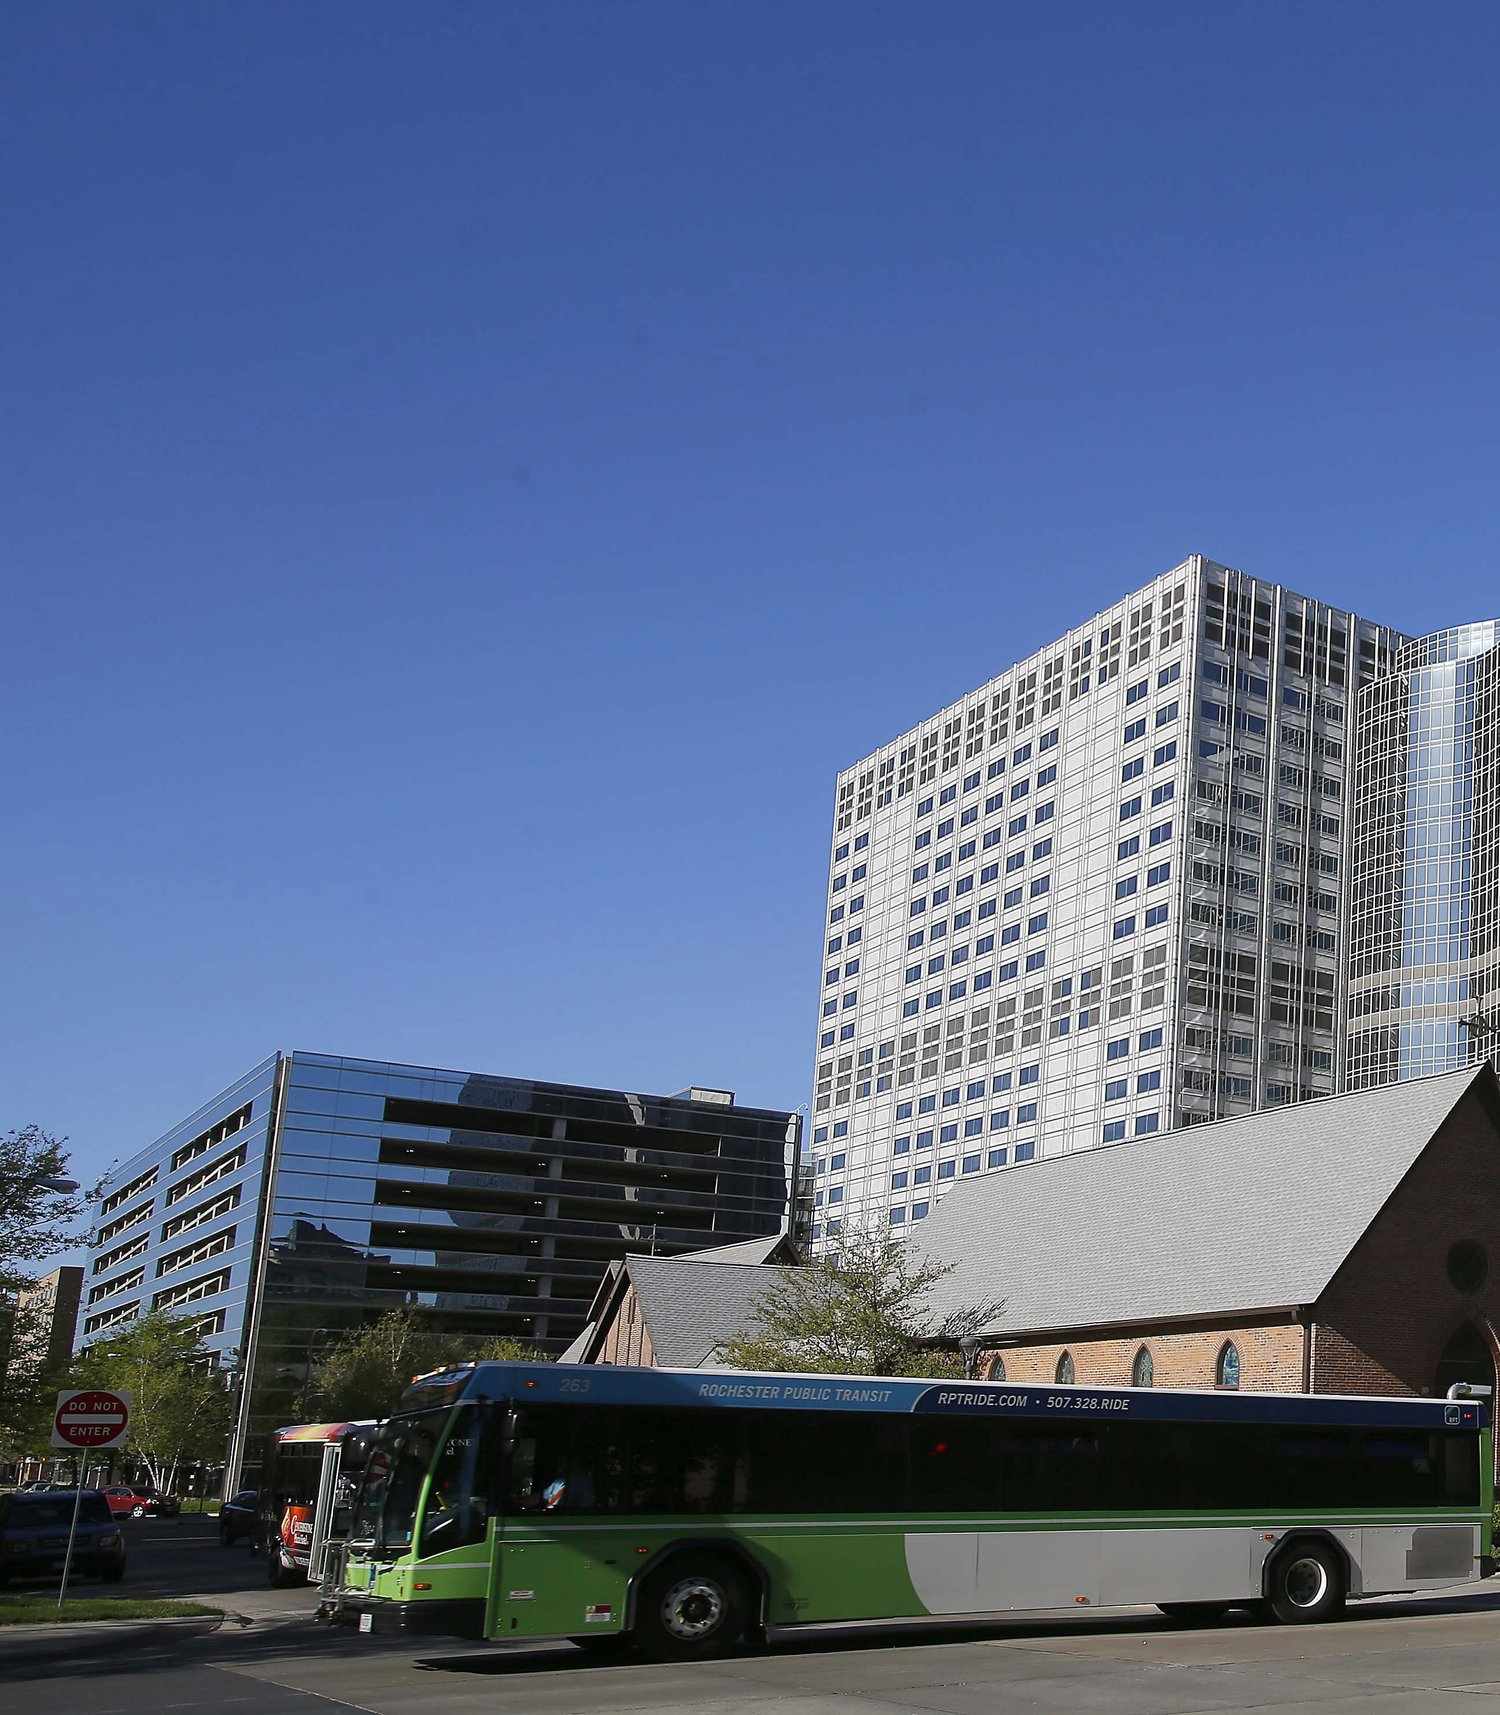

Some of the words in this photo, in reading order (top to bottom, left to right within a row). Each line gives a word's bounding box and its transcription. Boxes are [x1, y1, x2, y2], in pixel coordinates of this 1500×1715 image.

[559, 1378, 591, 1392] 263
[698, 1383, 780, 1399] ROCHESTER
[783, 1386, 832, 1401] PUBLIC
[835, 1388, 892, 1403] TRANSIT
[69, 1401, 87, 1411] DO
[93, 1401, 119, 1411] NOT
[937, 1392, 1028, 1407] RPTRIDE.COM
[1046, 1396, 1130, 1411] 507.328.RIDE
[69, 1426, 111, 1436] ENTER
